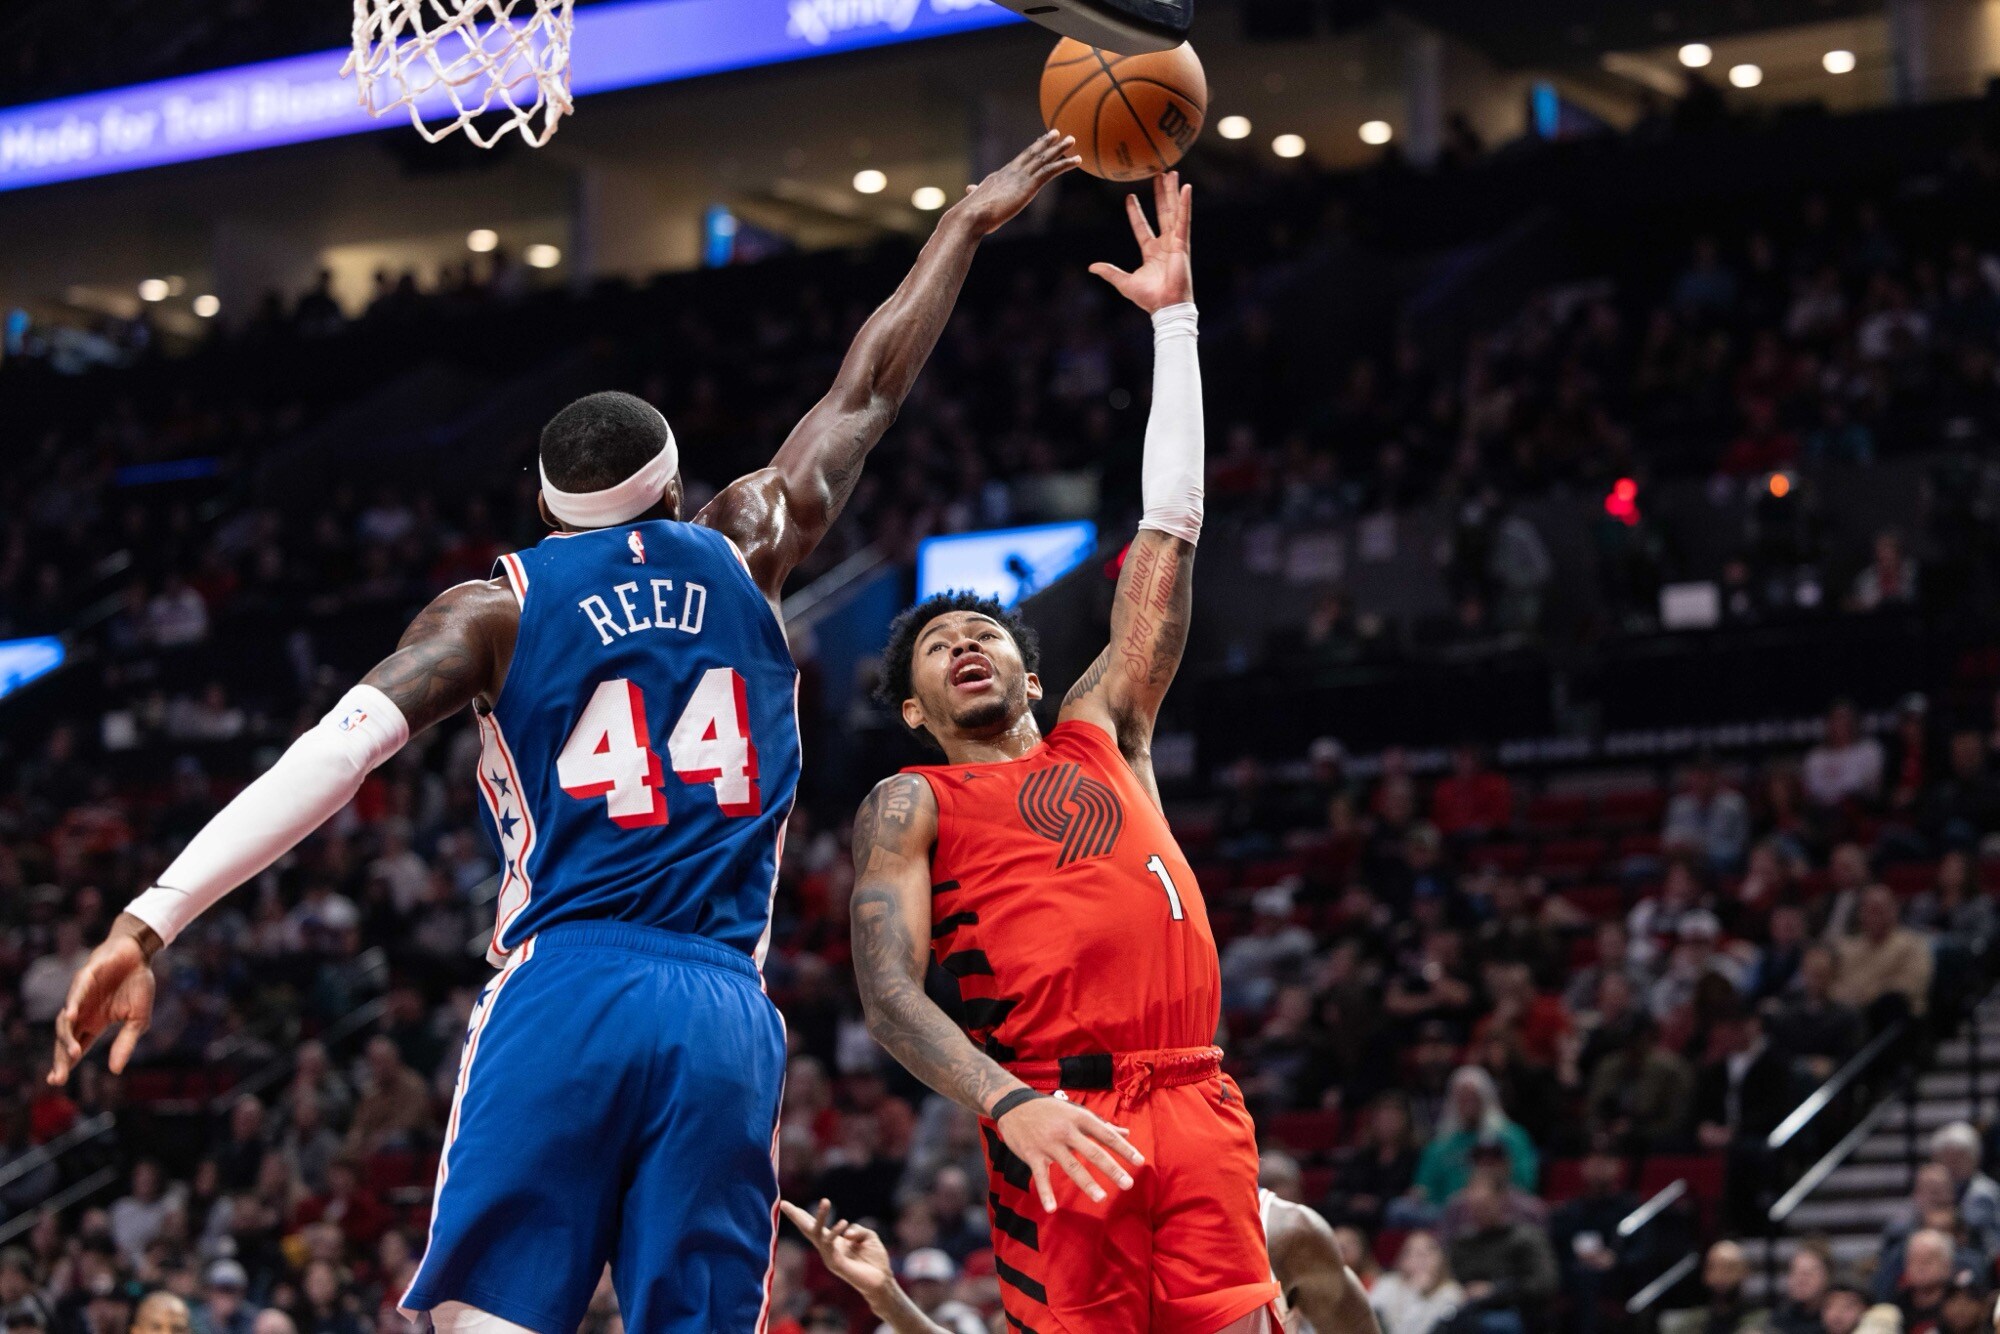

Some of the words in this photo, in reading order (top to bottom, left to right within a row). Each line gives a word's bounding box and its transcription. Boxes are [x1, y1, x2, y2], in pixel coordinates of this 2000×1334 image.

[1123, 542, 1155, 606] hungry
[1149, 547, 1179, 615] humble
[578, 578, 707, 646] REED
[1120, 612, 1153, 684] Stay
[556, 667, 762, 830] 44
[1146, 854, 1185, 921] 1
